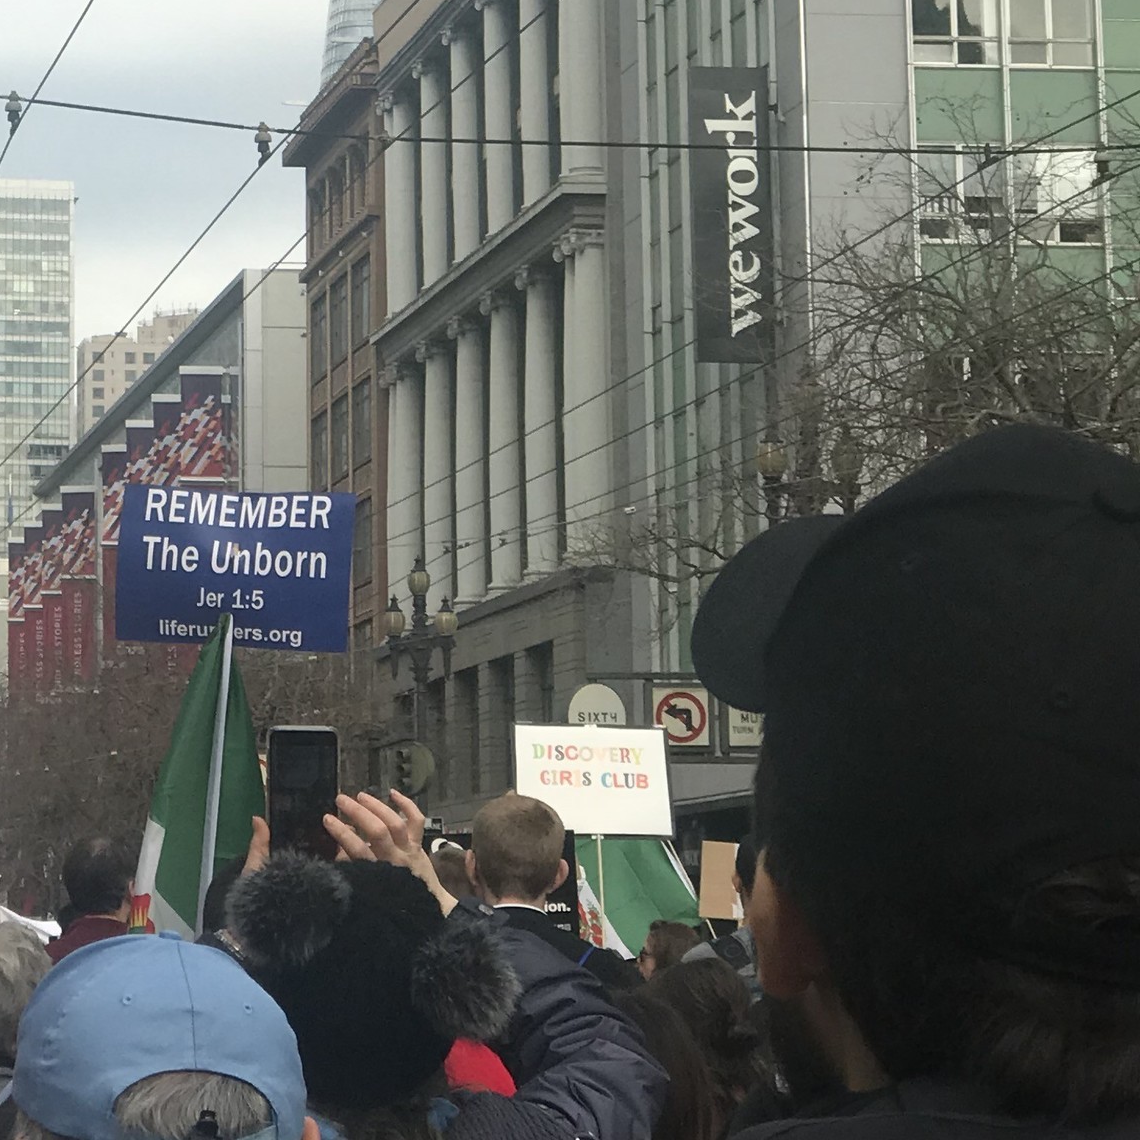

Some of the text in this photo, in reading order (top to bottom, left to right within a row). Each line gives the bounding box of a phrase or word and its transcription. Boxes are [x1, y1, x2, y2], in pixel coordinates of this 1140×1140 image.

[703, 90, 762, 338] wework
[144, 488, 332, 529] REMEMBER
[143, 535, 327, 579] The Unborn
[196, 587, 264, 610] Jer 1:5
[159, 619, 302, 647] liferuers.org
[532, 743, 645, 766] DISCOVERY
[600, 772, 650, 789] CLUB
